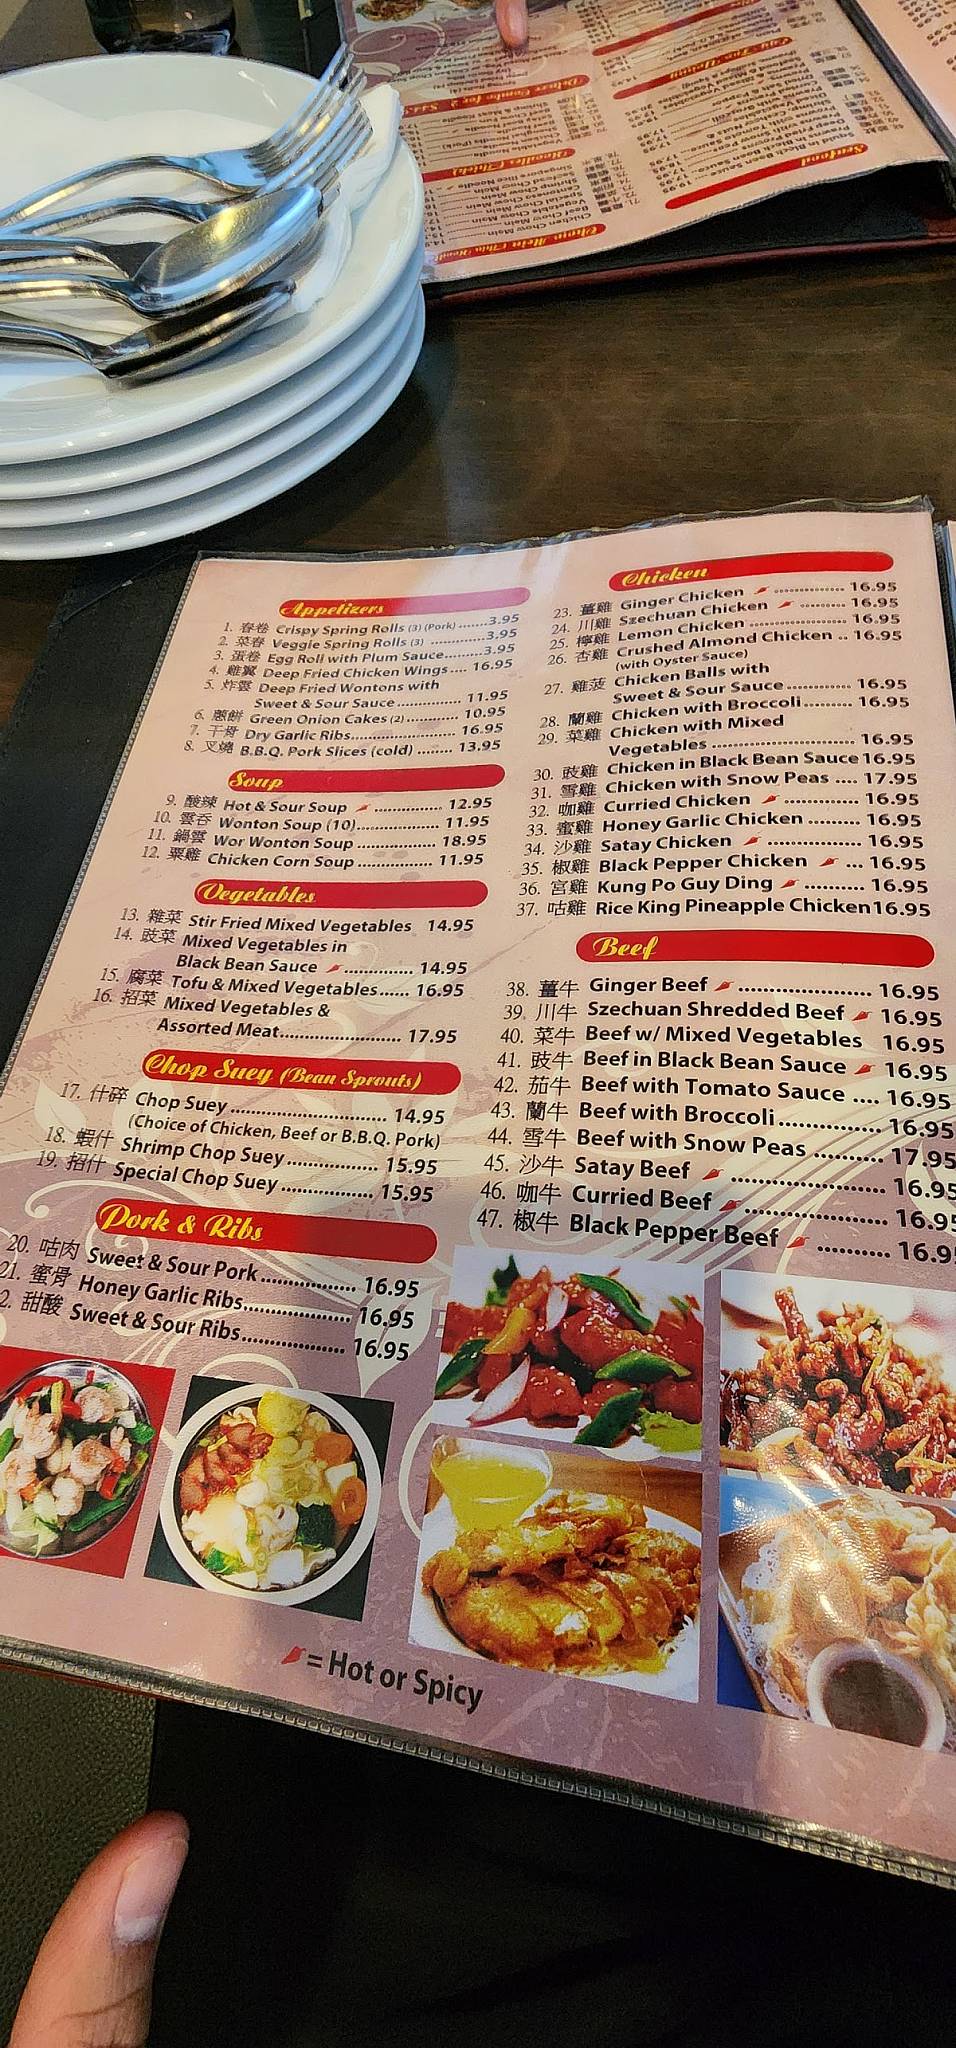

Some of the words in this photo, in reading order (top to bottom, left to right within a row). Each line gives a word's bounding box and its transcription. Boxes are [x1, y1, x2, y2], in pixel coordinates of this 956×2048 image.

[622, 566, 708, 587] Chicken
[280, 601, 384, 617] Appetizers
[551, 624, 569, 636] 24.
[619, 607, 696, 626] Szechuan
[701, 600, 768, 617] Chicken
[851, 598, 899, 609] 16.95
[223, 622, 233, 632] 1.
[276, 624, 320, 637] Crispy
[322, 624, 369, 637] Spring
[372, 622, 404, 634] Rolls
[408, 623, 422, 633] (3)
[424, 620, 456, 632] (Pork)
[488, 614, 519, 626] 3.95
[549, 638, 569, 651] 25.
[618, 625, 673, 642] Lemon
[677, 618, 745, 635] Chicken
[852, 614, 901, 625] 16.95
[190, 724, 200, 736] 7.
[244, 729, 270, 742] Dry
[273, 729, 318, 741] Garlic
[321, 729, 351, 740] Ribs
[461, 722, 503, 735] 16.95
[229, 771, 284, 791] Soup
[165, 794, 177, 807] 9.
[223, 801, 251, 813] Hot
[253, 801, 266, 813] &
[269, 801, 305, 814] Sour
[308, 801, 348, 815] Soup
[449, 797, 492, 811] 12.95
[526, 822, 547, 837] 33.
[602, 817, 661, 835] Honey
[666, 813, 721, 829] Garlic
[725, 811, 803, 827] Chicken
[867, 813, 922, 828] 16.95
[147, 828, 166, 841] 11.
[213, 834, 246, 848] Wor
[249, 836, 312, 850] Wonton
[314, 838, 354, 851] Soup
[442, 834, 487, 847] 18.95
[196, 881, 317, 904] Vegetables
[518, 881, 541, 897] 36.
[597, 878, 647, 897] Kung
[652, 878, 675, 892] Po
[680, 876, 720, 895] Guy
[725, 875, 774, 894] Ding
[871, 878, 929, 895] 16.95
[121, 908, 139, 922] 13.
[188, 914, 217, 929] Stir
[220, 916, 262, 931] Fried
[266, 917, 316, 933] Mixed
[320, 918, 412, 936] Vegetables
[428, 918, 474, 933] 14.95
[592, 935, 658, 961] Beef
[100, 967, 119, 982] 15.
[171, 975, 208, 992] Tofu
[212, 977, 225, 992] &
[228, 978, 279, 995] Mixed
[284, 980, 378, 998] Vegetables
[416, 982, 464, 998] 16.95
[503, 1004, 527, 1021] 39.
[535, 1003, 578, 1023] 川牛
[587, 1000, 682, 1020] Szechuan
[686, 1001, 790, 1020] Shredded
[795, 1003, 844, 1022] Beef
[880, 1008, 942, 1028] 16.95
[143, 1052, 207, 1079] Chop
[213, 1058, 272, 1085] Suey
[279, 1066, 337, 1086] (Bean
[341, 1069, 422, 1090] Sprouts)
[60, 1081, 81, 1101] 17.
[135, 1091, 181, 1112] Chop
[184, 1095, 227, 1117] Suey
[394, 1108, 446, 1126] 14.95
[493, 1075, 519, 1094] 42.
[527, 1074, 572, 1096] 茄牛
[581, 1075, 629, 1095] Beef
[633, 1077, 679, 1096] with
[684, 1078, 771, 1099] Tomato
[777, 1082, 845, 1103] Sauce
[886, 1090, 951, 1111] 16.95
[128, 1113, 184, 1133] (Choice
[187, 1116, 207, 1134] of
[210, 1119, 277, 1140] Chicken,
[281, 1124, 317, 1141] Beef
[320, 1129, 338, 1142] or
[341, 1130, 391, 1147] B.B.Q.
[394, 1131, 440, 1151] Pork)
[44, 1126, 67, 1145] 18.
[120, 1136, 185, 1162] Shrimp
[189, 1141, 237, 1164] Chop
[239, 1145, 286, 1169] Suey
[385, 1158, 438, 1176] 15.95
[483, 1154, 510, 1173] 45.
[518, 1155, 565, 1178] 沙牛
[574, 1156, 634, 1181] Satay
[640, 1158, 690, 1180] Beef
[99, 1203, 170, 1234] Pork
[177, 1210, 196, 1235] &
[203, 1214, 264, 1242] Ribs
[6, 1234, 29, 1254] 20.
[87, 1246, 144, 1273] Sweet
[147, 1253, 162, 1273] &
[166, 1255, 211, 1278] Sour
[213, 1260, 259, 1283] Pork
[364, 1276, 420, 1300] 16.95
[328, 1650, 375, 1684] Hot
[379, 1668, 407, 1690] or
[413, 1669, 483, 1715] Spicy
